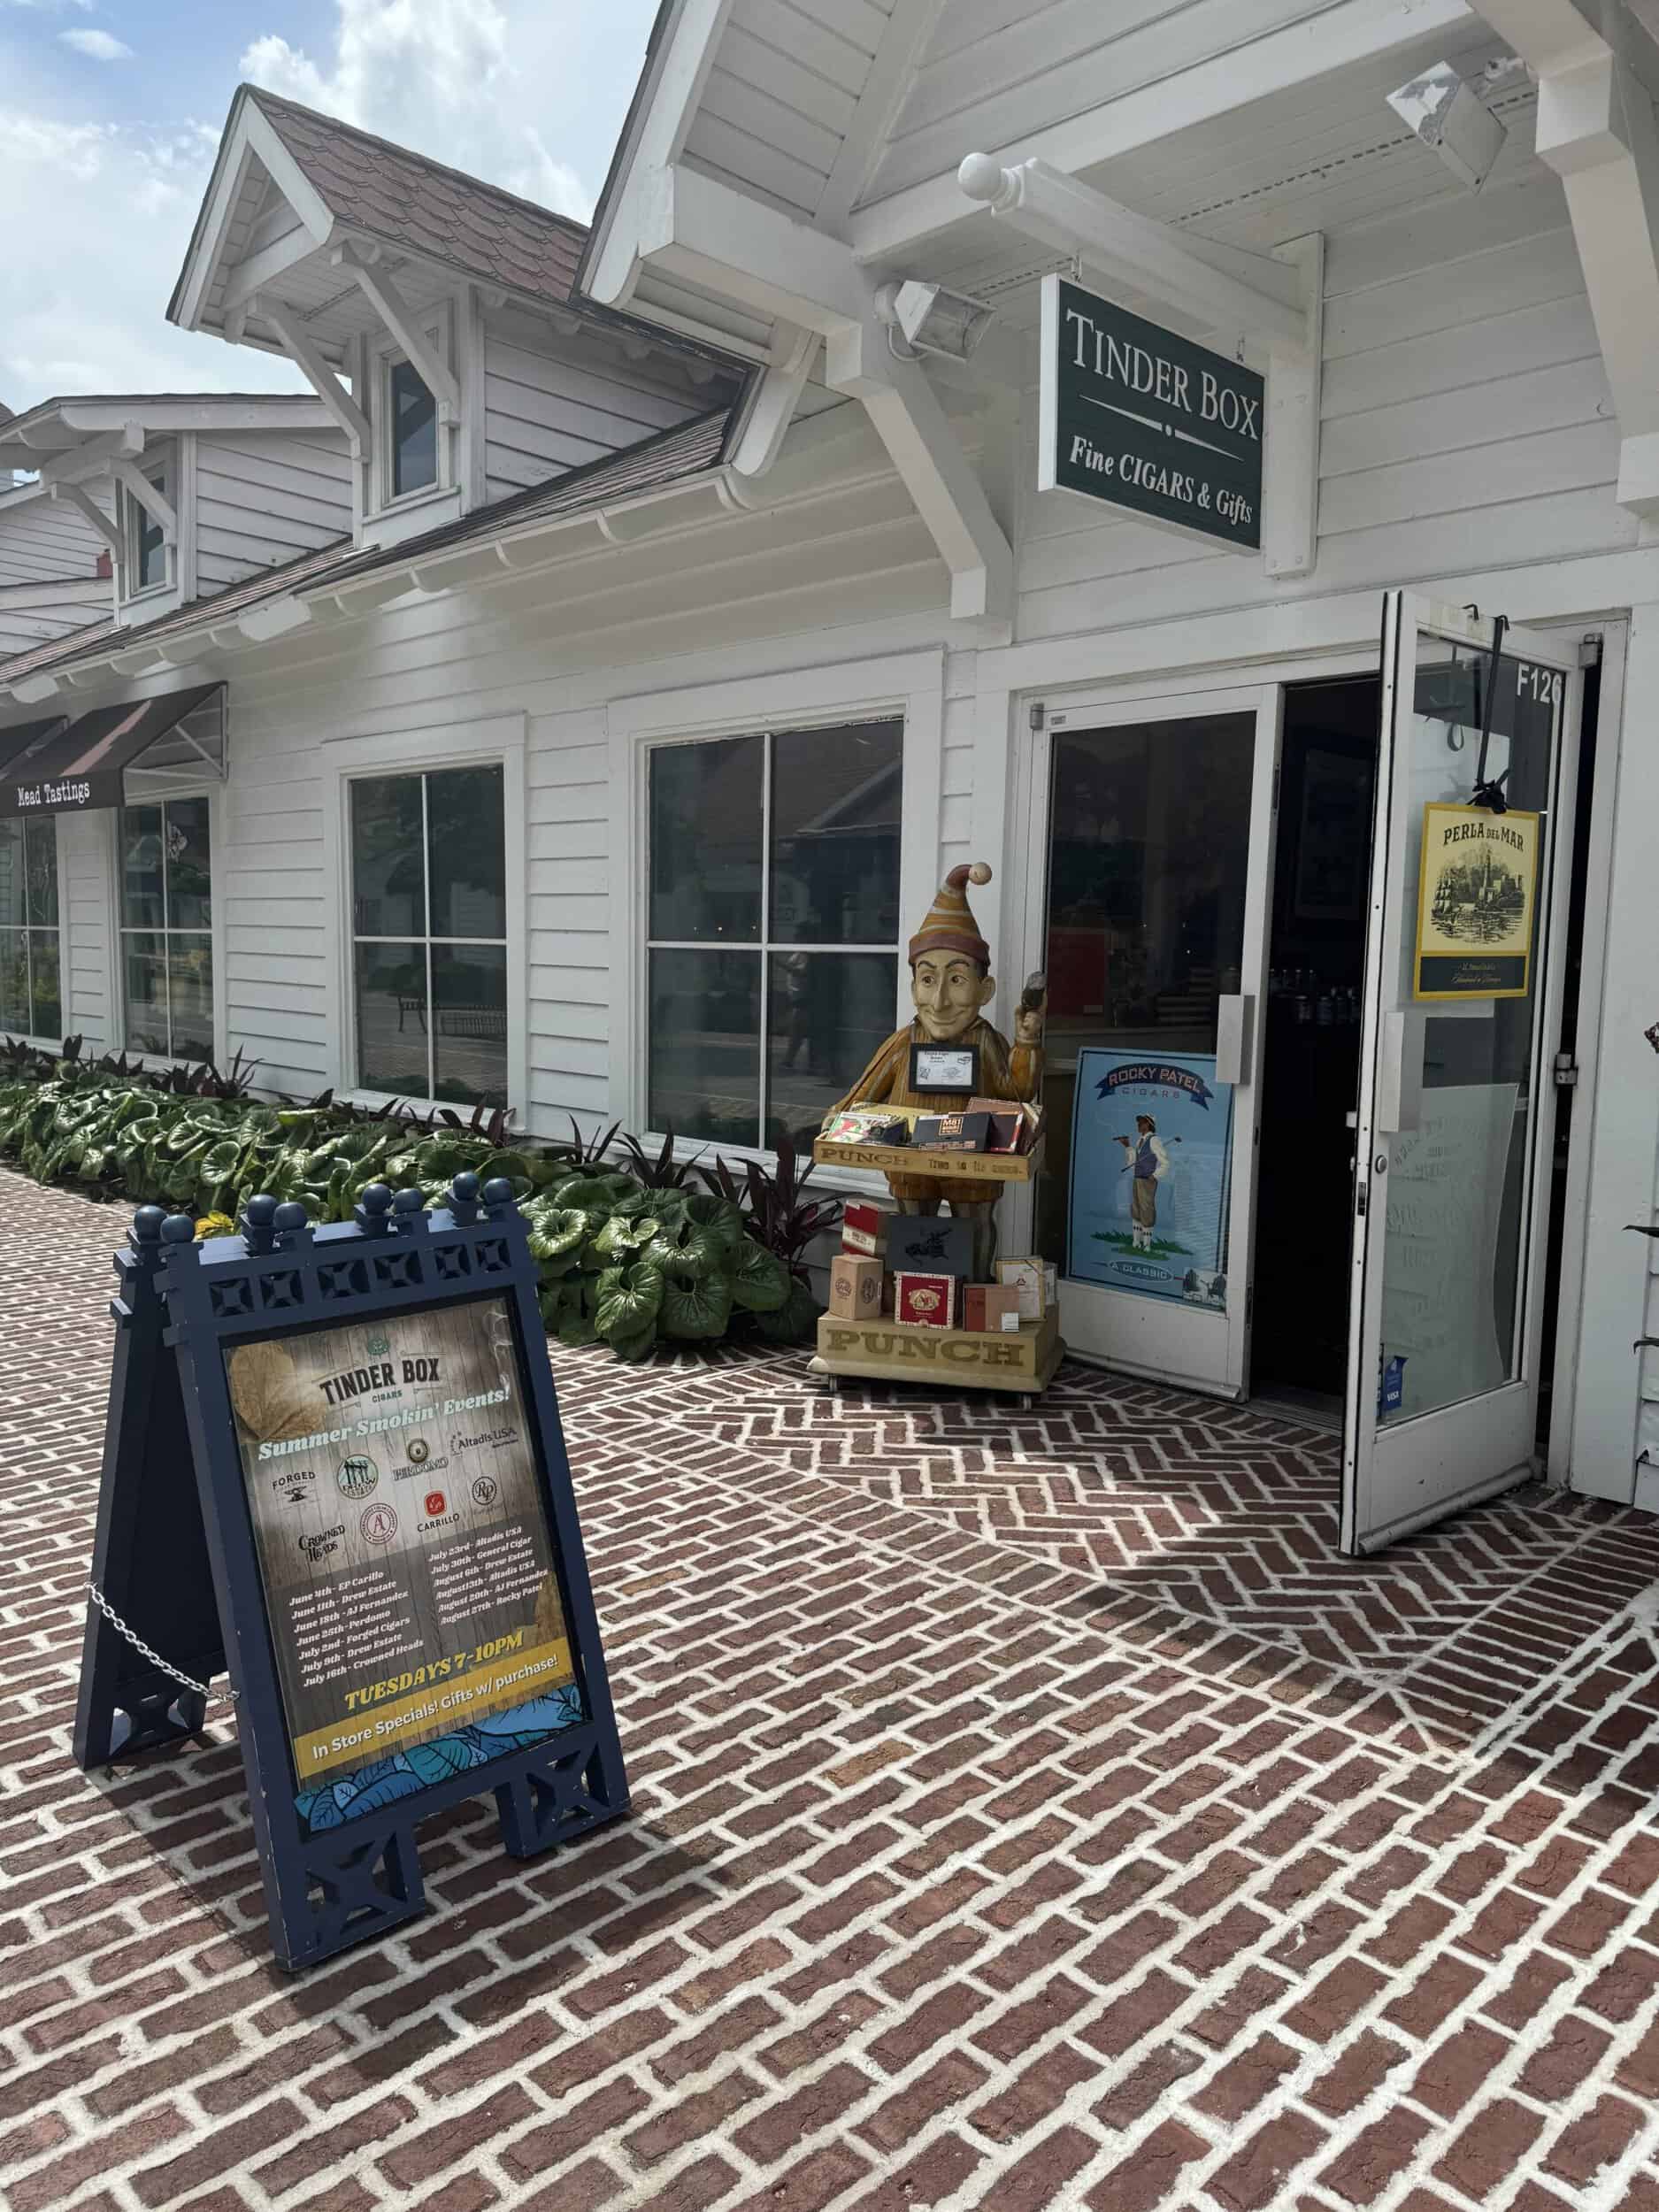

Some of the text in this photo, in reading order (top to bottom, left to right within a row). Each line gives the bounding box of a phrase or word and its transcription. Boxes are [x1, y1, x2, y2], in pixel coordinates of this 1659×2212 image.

[1066, 308, 1259, 441] TINDER BOX
[1069, 435, 1253, 526] Fine CIGARS & Gifts
[18, 780, 90, 807] Mead Tastings
[1443, 822, 1525, 852] PERLA DEL MAR
[1108, 1067, 1201, 1093] ROCKY PATEL
[1121, 1087, 1179, 1099] CIGARS
[820, 1148, 909, 1166] PUNCH
[825, 1329, 1025, 1367] PUNCH
[319, 1357, 440, 1406] TINDER BOX
[372, 1389, 403, 1403] CIGARS
[258, 1387, 511, 1460] Summer Smokin' Events!
[457, 1433, 492, 1449] Altadis
[494, 1426, 518, 1440] USA
[273, 1471, 316, 1490] FORGED
[417, 1513, 460, 1532] CARRILLO
[429, 1550, 447, 1562] July
[476, 1532, 504, 1548] Altadis
[505, 1526, 522, 1537] USA
[432, 1563, 449, 1574] July
[477, 1543, 509, 1559] General
[510, 1537, 532, 1548] Cigar
[434, 1571, 464, 1586] August
[485, 1557, 506, 1570] Drew
[508, 1549, 533, 1562] Estate
[489, 1566, 518, 1581] Altadis
[518, 1559, 535, 1571] USA
[289, 1592, 313, 1606] June
[339, 1580, 351, 1591] EP
[352, 1571, 384, 1586] Carillo
[291, 1605, 315, 1619] June
[342, 1592, 366, 1604] Drew
[368, 1580, 396, 1594] Estate
[438, 1597, 468, 1612] August
[506, 1569, 548, 1589] Fernandez
[441, 1609, 471, 1624] August
[496, 1592, 521, 1605] Rocky
[523, 1582, 542, 1597] Patel
[294, 1618, 318, 1632] June
[319, 1612, 340, 1624] 18th
[359, 1591, 409, 1612] Fernandez
[296, 1632, 320, 1646] June
[299, 1647, 320, 1660] July
[347, 1625, 379, 1644] Forged
[380, 1617, 411, 1632] Cigars
[301, 1660, 322, 1673] July
[347, 1645, 372, 1658] Drew
[373, 1633, 403, 1648] Estate
[303, 1673, 325, 1687] July
[353, 1648, 395, 1670] Crowned
[396, 1640, 424, 1655] Heads
[344, 1628, 525, 1711] TUESDAYS 7-10PM
[312, 1654, 558, 1760] In Store Specials! Gifts w/ purchase!
